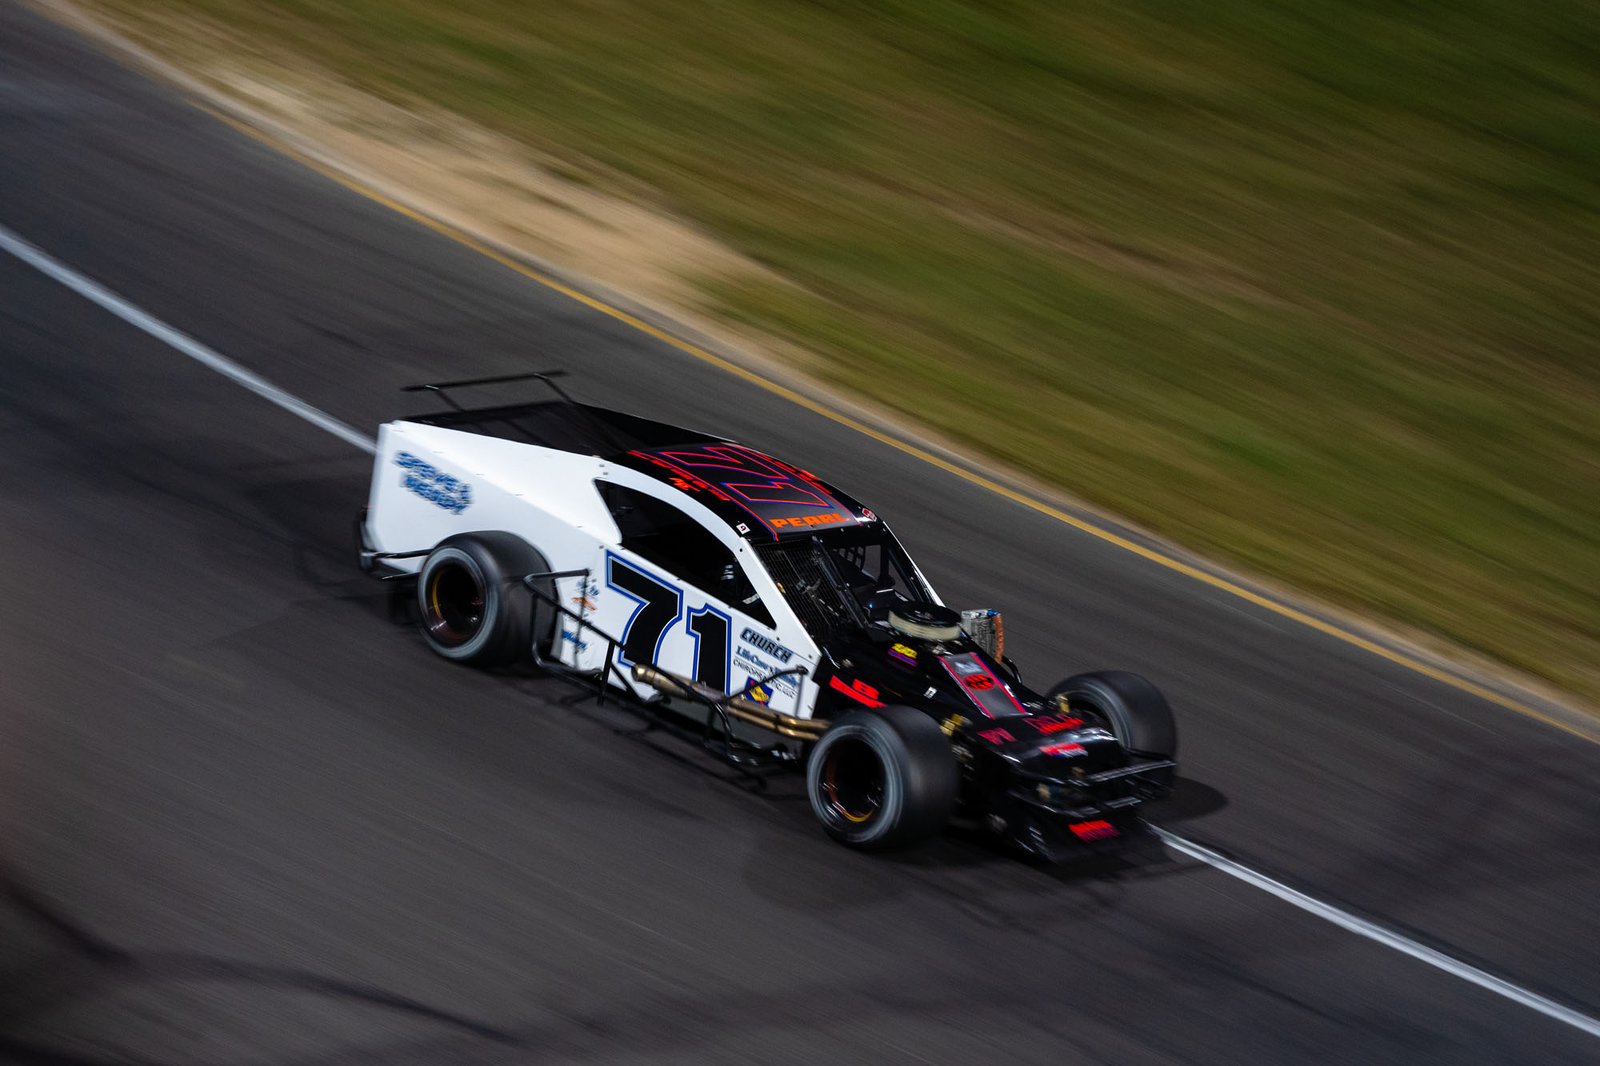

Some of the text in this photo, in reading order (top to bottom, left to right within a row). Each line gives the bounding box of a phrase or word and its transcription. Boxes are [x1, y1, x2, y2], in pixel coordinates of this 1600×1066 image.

[769, 512, 850, 529] PEARL
[606, 549, 733, 697] 71
[740, 627, 794, 664] CHURCH
